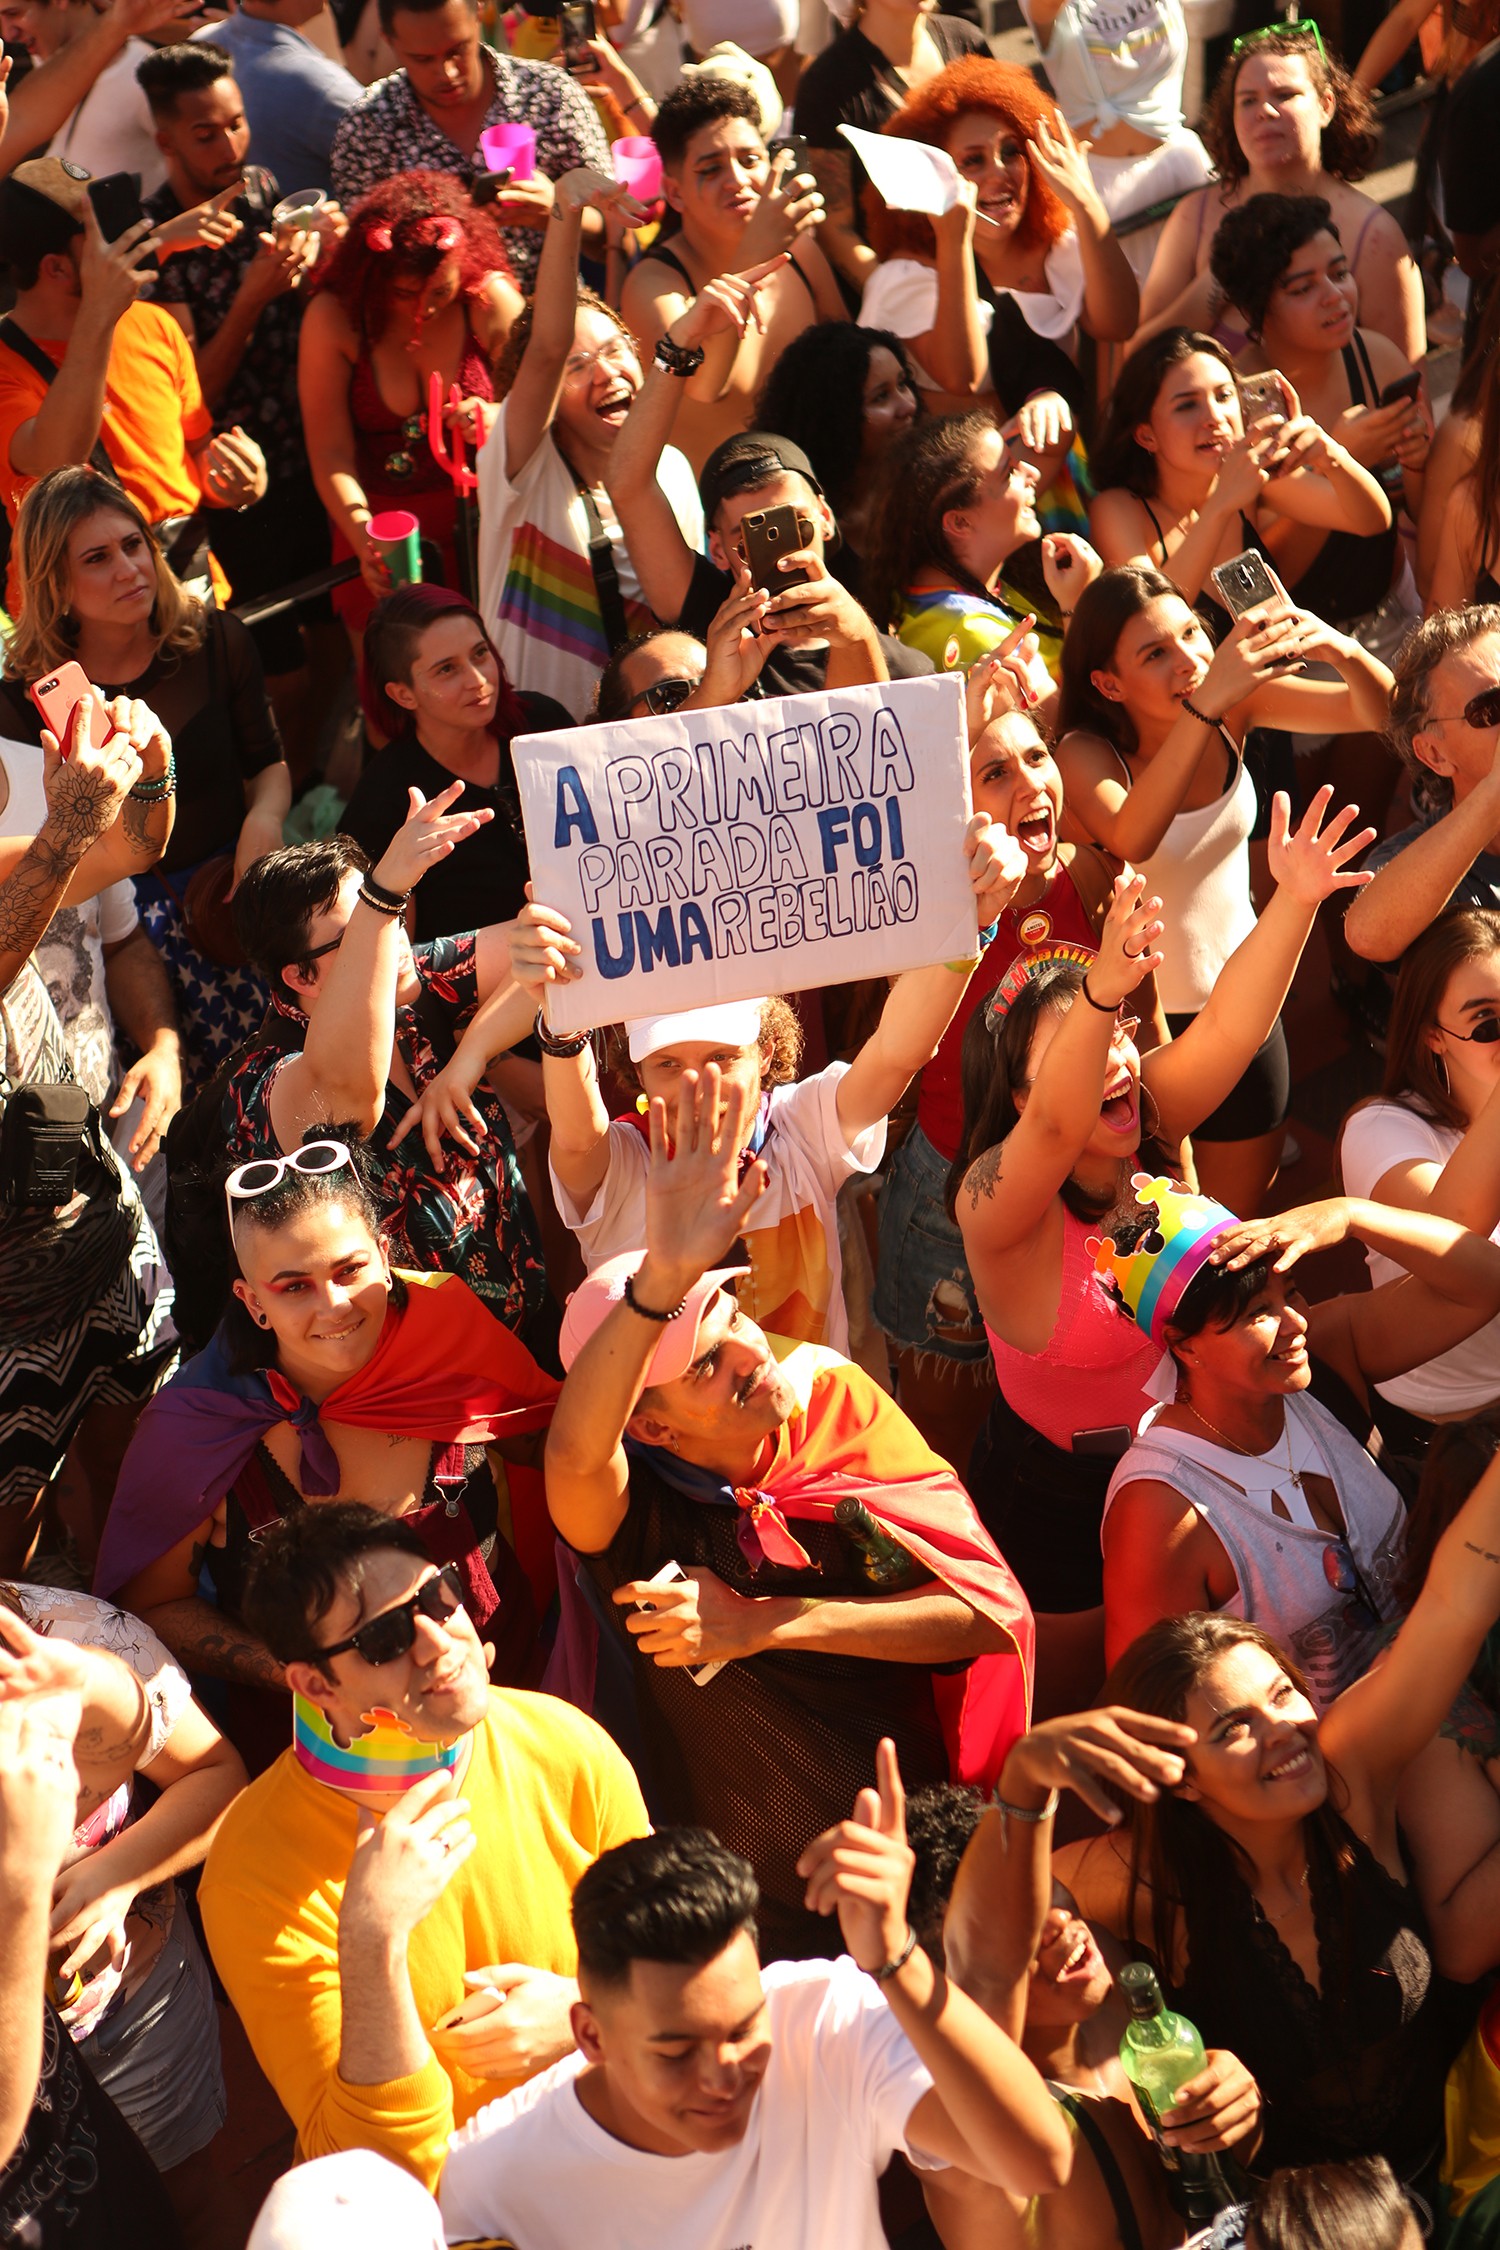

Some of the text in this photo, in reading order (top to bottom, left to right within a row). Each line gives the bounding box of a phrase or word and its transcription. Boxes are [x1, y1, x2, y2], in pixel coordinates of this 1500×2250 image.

[554, 707, 915, 849] A PRIMEIRA
[578, 796, 905, 913] PARADA FOI
[592, 862, 919, 980] UMA REBELIÃO
[1025, 945, 1097, 977] PROU
[28, 1184, 68, 1197] adidas
